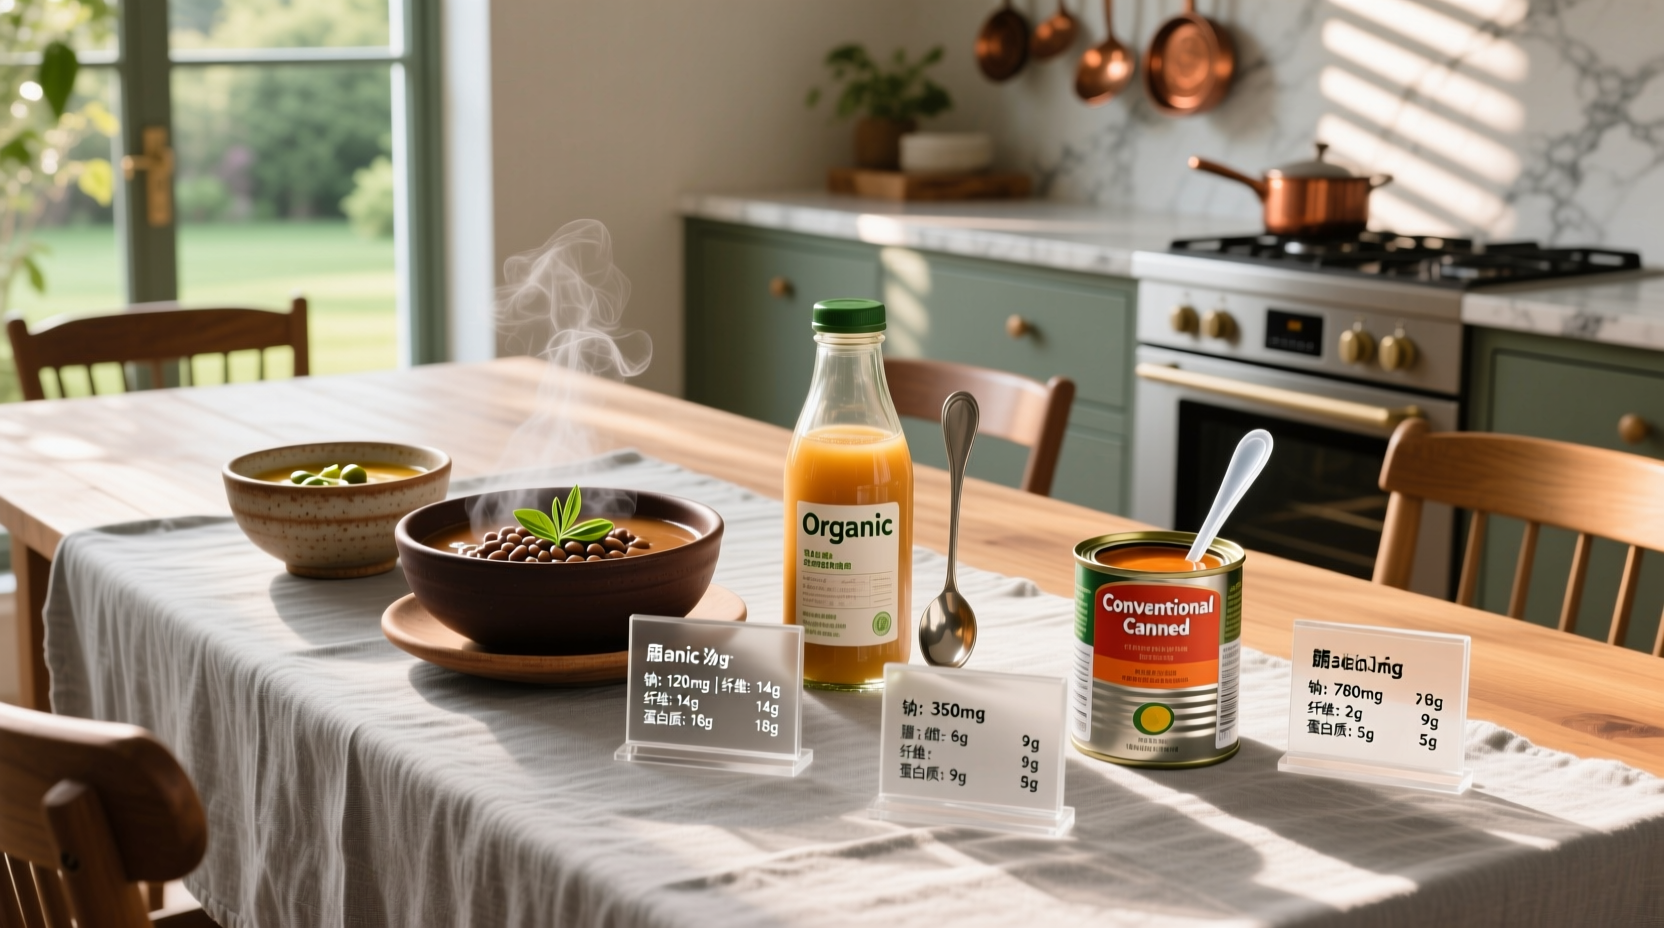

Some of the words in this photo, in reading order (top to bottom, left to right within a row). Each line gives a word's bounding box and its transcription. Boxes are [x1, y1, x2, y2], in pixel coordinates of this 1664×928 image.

[803, 512, 893, 544] Organic
[1102, 593, 1214, 615] Conventional
[1123, 617, 1190, 636] Canned
[667, 675, 710, 693] 120mg
[756, 681, 780, 698] 14g
[677, 695, 699, 710] 14g
[756, 701, 779, 717] 14g
[931, 701, 985, 723] 350mg
[1345, 705, 1362, 722] 2g
[691, 714, 713, 730] 16g
[1421, 713, 1438, 730] 9g
[951, 730, 968, 746] 6g
[1357, 726, 1374, 743] 5g
[1419, 734, 1437, 750] 5g
[1022, 735, 1040, 752] 9g
[1022, 756, 1039, 773] 9g
[950, 769, 966, 786] 9g
